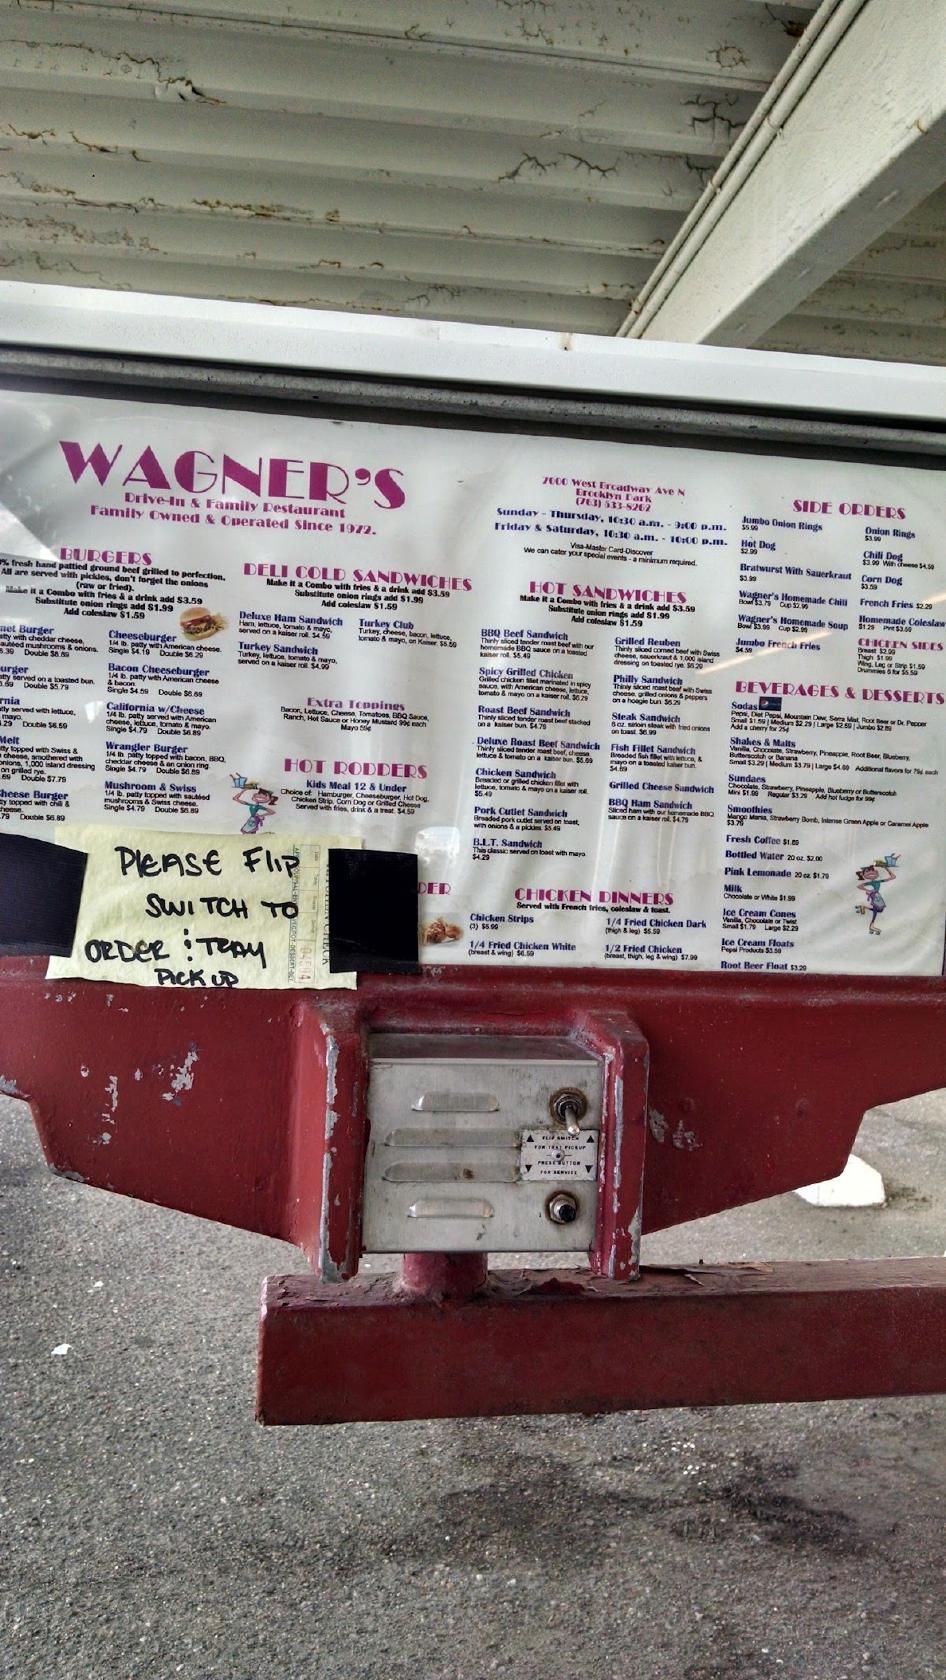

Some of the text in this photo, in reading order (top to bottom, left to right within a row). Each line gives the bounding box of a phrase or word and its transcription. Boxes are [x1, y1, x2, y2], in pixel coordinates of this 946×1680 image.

[59, 441, 406, 509] WAGNER'S
[571, 479, 595, 488] West
[599, 482, 650, 493] Broadway
[655, 487, 674, 495] Ave
[678, 488, 684, 496] N
[576, 488, 651, 502] Brooklyn Park
[124, 492, 344, 517] Drive-In & Family Restaurant
[793, 500, 905, 519] SIDE ORDERS
[90, 505, 142, 518] Family
[149, 510, 199, 523] Owned
[206, 514, 214, 524] &
[220, 515, 288, 528] Operated
[295, 519, 332, 531] Since
[497, 507, 537, 517] Sunday
[551, 510, 603, 521] Thursday,
[608, 516, 635, 525] 10:30
[494, 522, 530, 531] Friday
[546, 525, 598, 535] Saturday,
[604, 529, 630, 539] 10:30
[670, 536, 697, 544] 10:00
[865, 526, 915, 539] Onion Rings
[741, 539, 775, 550] Hot Dog
[60, 547, 151, 565] BURGERS
[863, 550, 902, 562] Chili Dog
[1, 567, 12, 575] All
[31, 569, 58, 577] served
[60, 570, 77, 578] with
[80, 572, 112, 581] pickles,
[114, 574, 135, 582] don't
[138, 576, 162, 585] forget
[165, 577, 178, 585] the
[180, 579, 208, 587] onions
[244, 562, 471, 590] DELI COLD SANDWICHES
[530, 581, 686, 604] HOT SANDWICHES
[860, 598, 888, 607] French
[891, 600, 913, 608] Fries
[239, 611, 342, 625] Deluxe Ham Sandwich
[359, 618, 414, 629] Turkey Club
[108, 630, 176, 643] Cheeseburger
[858, 638, 907, 649] CHICKEN
[613, 674, 682, 685] Philly Sandwich
[735, 680, 944, 704] BEVERAGES & DESSERTS
[106, 702, 204, 715] California w/Cheese
[307, 698, 404, 711] Extra Toppings
[731, 701, 759, 710] Sodas
[612, 712, 680, 722] Steak Sandwich
[106, 725, 126, 734] Single
[730, 736, 761, 745] Shakes
[764, 738, 770, 746] &
[106, 741, 187, 755] Wrangler Burger
[284, 758, 426, 778] HOT RODDERS
[728, 774, 766, 782] Sundaes
[104, 781, 196, 792] Mushroom & Swiss
[306, 780, 406, 792] Kids Meal 12 & Under
[474, 806, 567, 817] Pork Cutlet Sandwich
[727, 805, 772, 813] Smoothies
[726, 834, 751, 842] Fresh
[754, 836, 780, 844] Coffee
[725, 850, 756, 858] Bottled
[759, 851, 784, 860] Water
[115, 846, 222, 878] PLEASE
[724, 884, 742, 892] Milk
[514, 888, 673, 905] CHICKEN DINNERS
[145, 893, 248, 919] SWITCH
[261, 900, 299, 919] TO
[516, 901, 541, 909] Served
[589, 904, 608, 912] fries,
[470, 913, 534, 923] Chicken Strips
[85, 939, 170, 962] ORDER
[196, 937, 267, 969] TRAY
[720, 960, 740, 969] Root
[744, 961, 763, 969] Beer
[766, 962, 787, 970] Float
